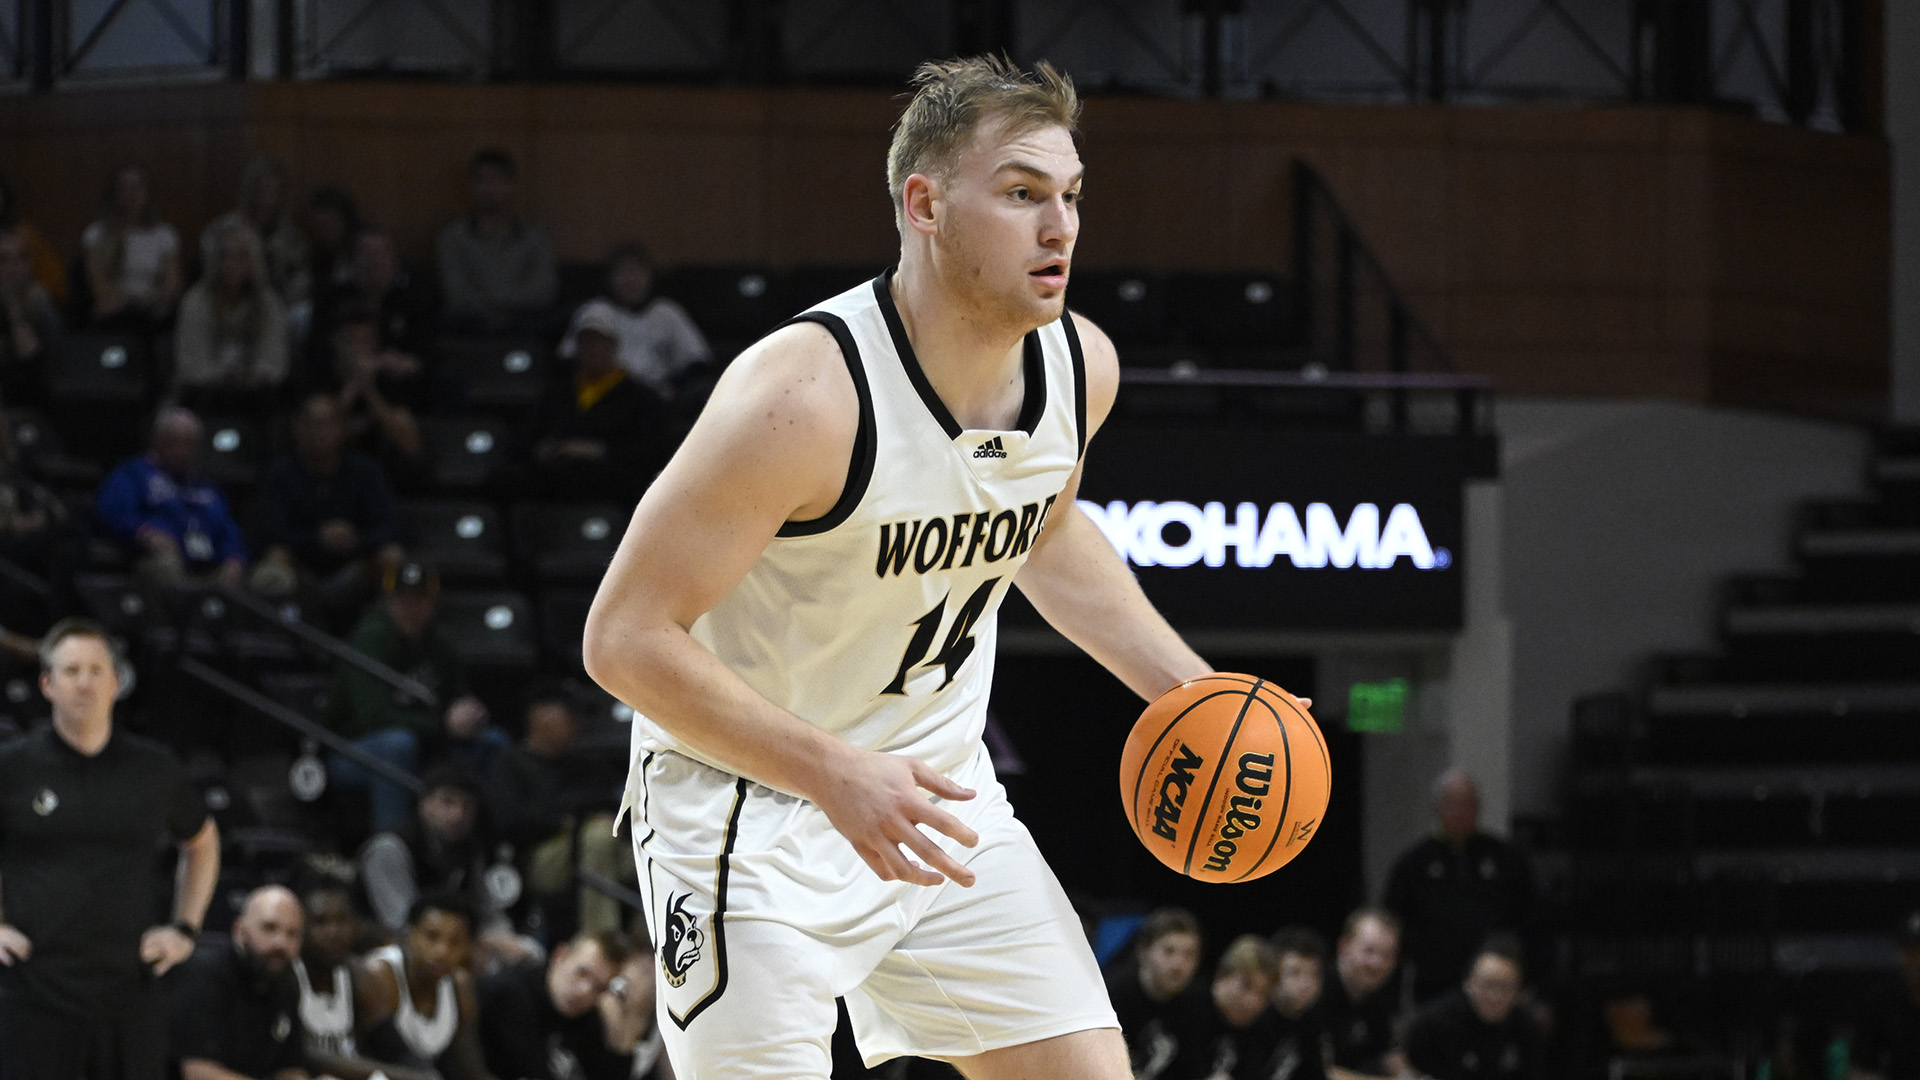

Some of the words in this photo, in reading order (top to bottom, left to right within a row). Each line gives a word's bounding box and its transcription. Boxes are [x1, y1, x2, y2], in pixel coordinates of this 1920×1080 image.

[973, 448, 1007, 459] adidas
[1076, 500, 1435, 569] KOHAMA
[877, 575, 1005, 697] 14
[1152, 743, 1204, 842] NCAA
[1156, 738, 1181, 778] OFFICIAL
[1203, 751, 1275, 872] Wilson
